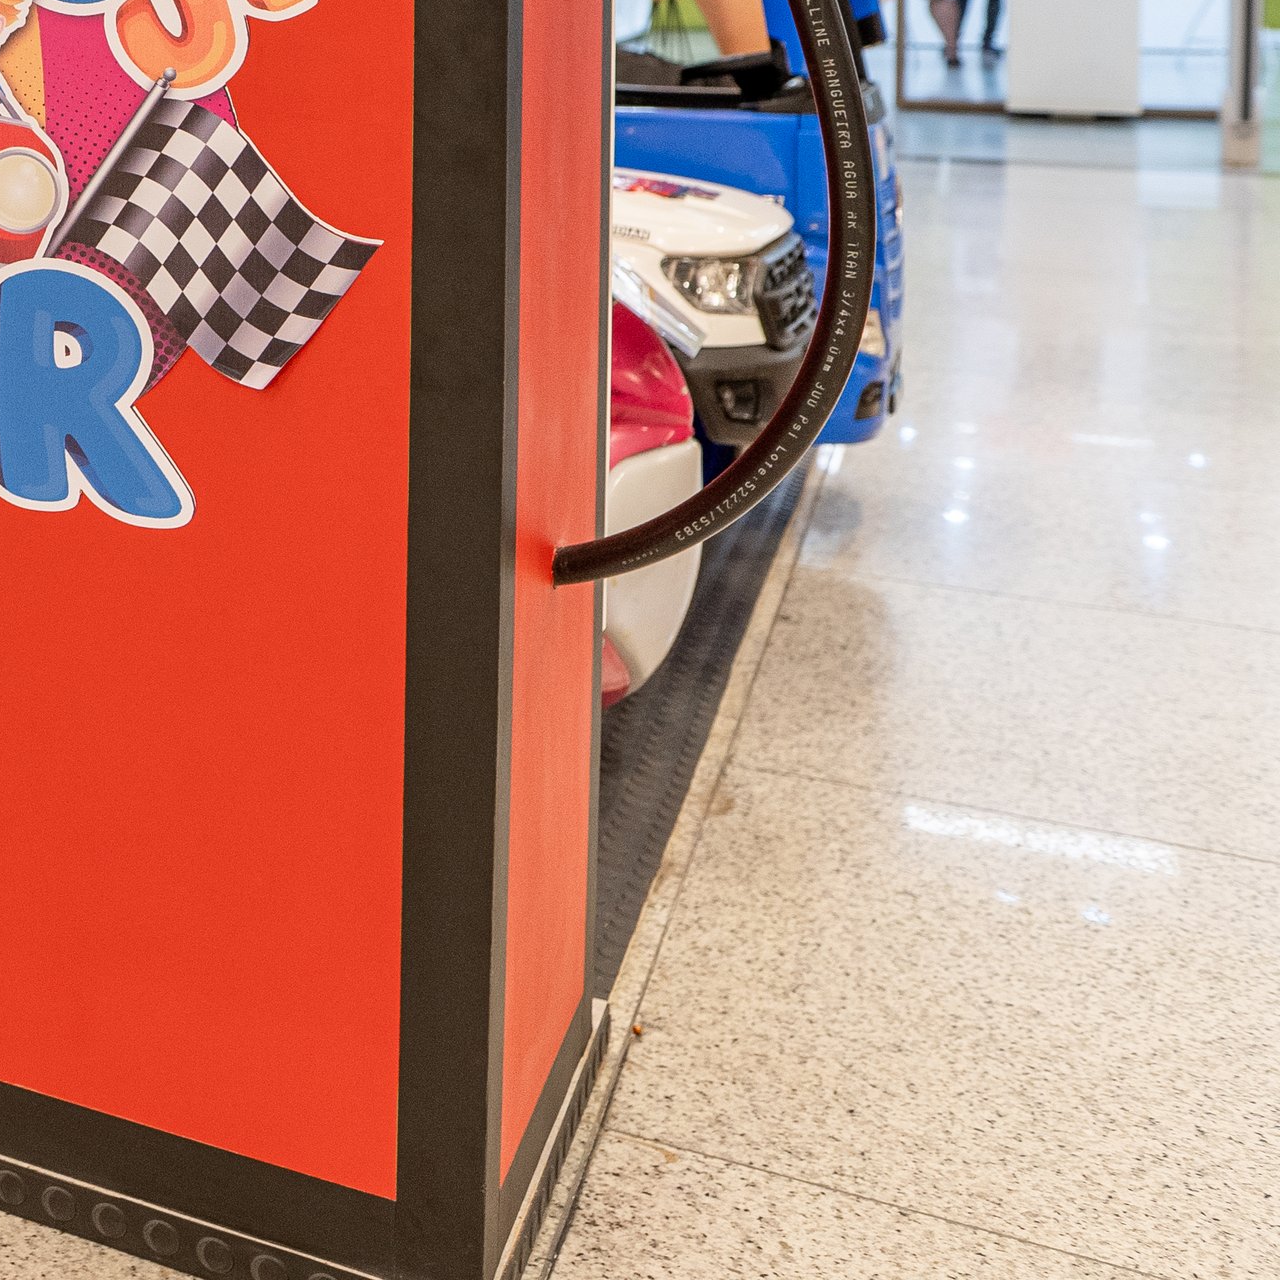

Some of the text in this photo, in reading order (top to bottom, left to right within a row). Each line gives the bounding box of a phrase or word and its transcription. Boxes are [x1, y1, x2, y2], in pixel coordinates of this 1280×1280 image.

[808, 7, 831, 47] LINE
[822, 58, 853, 149] MANGUEIRA
[842, 160, 858, 199] AGUA
